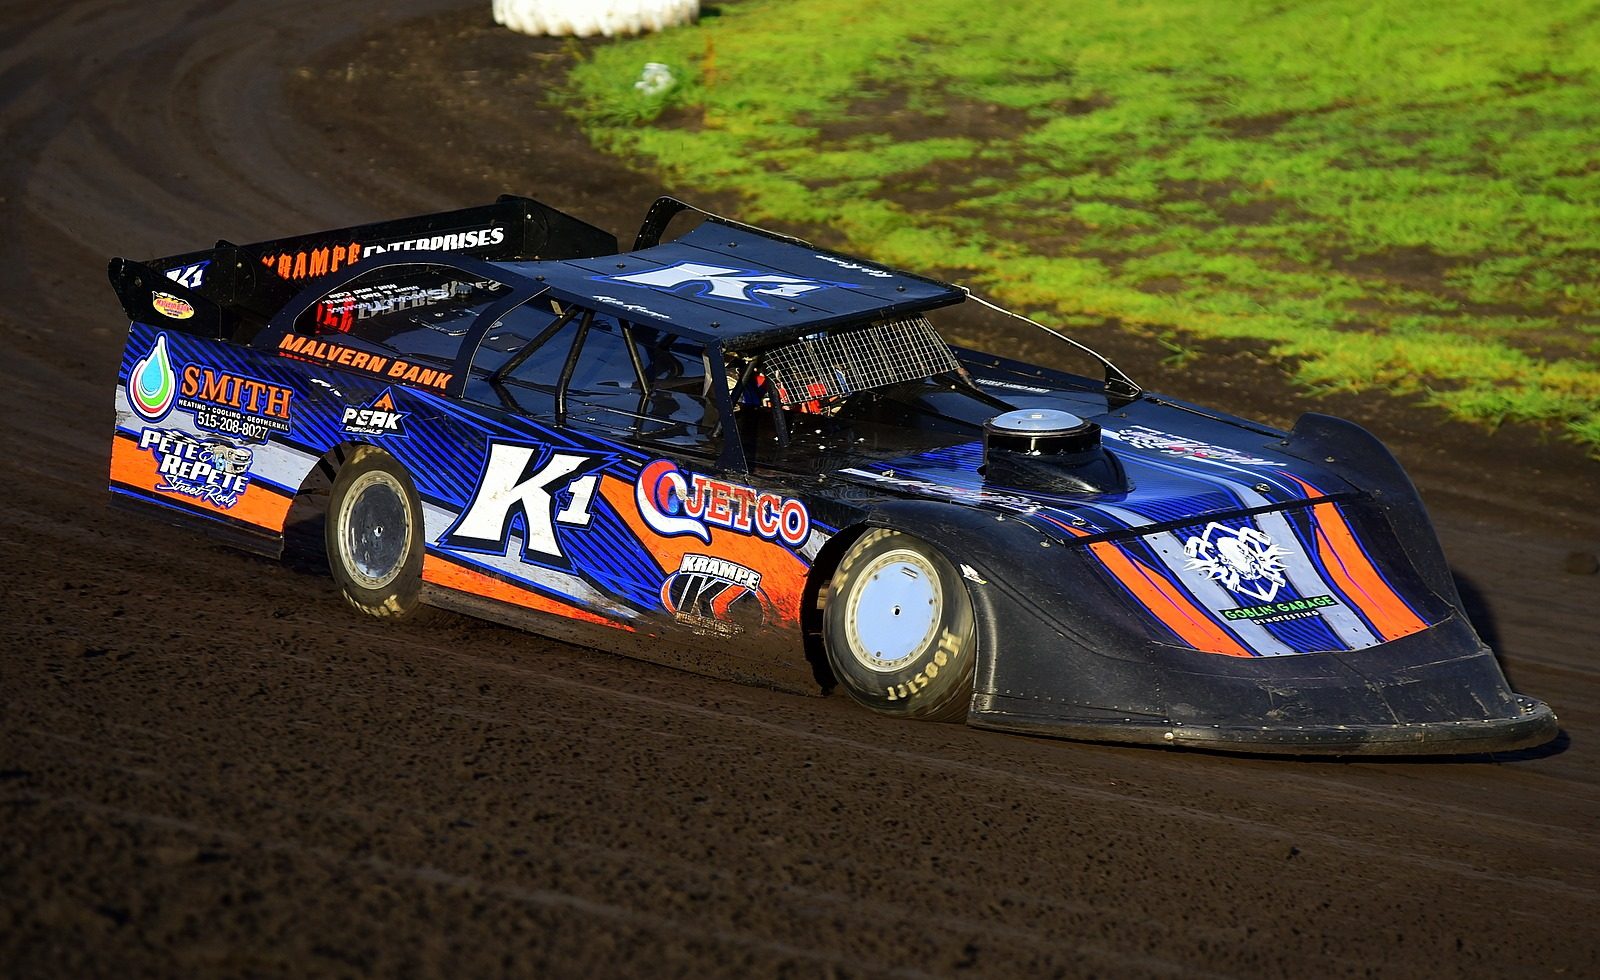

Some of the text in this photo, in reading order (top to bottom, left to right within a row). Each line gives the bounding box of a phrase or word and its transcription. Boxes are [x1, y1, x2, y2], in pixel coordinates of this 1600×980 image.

[613, 263, 820, 300] K1
[278, 333, 388, 373] MALVERN
[387, 359, 452, 390] BANK
[182, 365, 292, 419] SMITH
[178, 399, 289, 431] HEATING COOLING GEOTHERMAL
[198, 411, 269, 440] 515-208-8027
[342, 407, 403, 430] PEAK
[345, 425, 384, 435] DECALS
[140, 429, 198, 460] PETE
[157, 474, 238, 507] Street Rods
[453, 443, 598, 558] K1
[681, 555, 759, 591] KRAMPE
[1224, 596, 1336, 620] GOBLIN GARAGE
